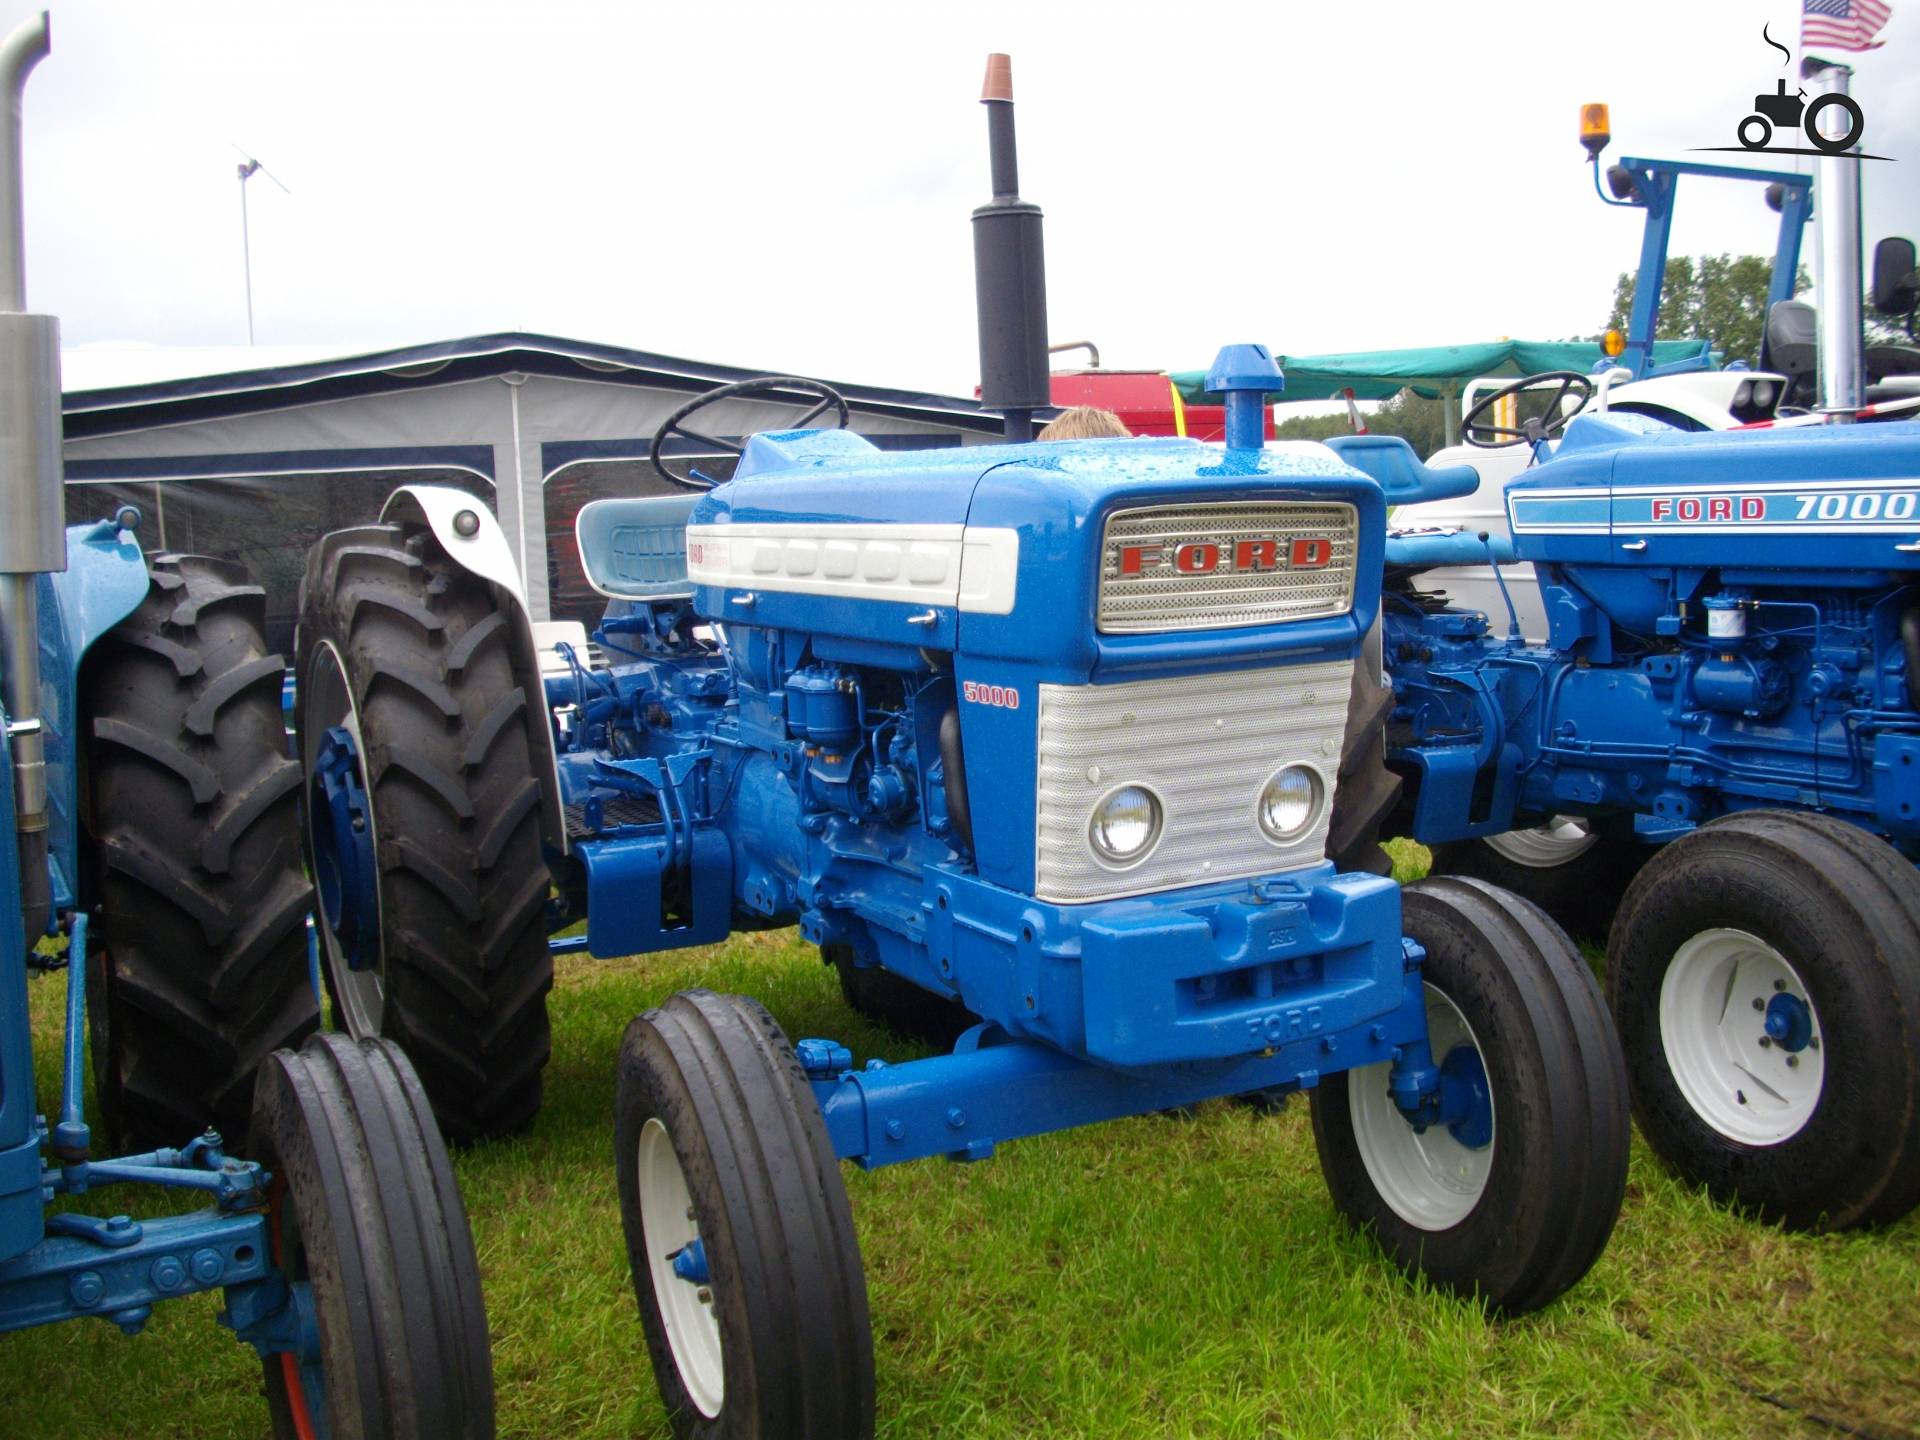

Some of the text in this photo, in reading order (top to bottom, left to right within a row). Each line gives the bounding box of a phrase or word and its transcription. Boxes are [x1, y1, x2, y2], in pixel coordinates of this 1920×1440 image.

[1651, 493, 1916, 522] FORD 7000
[1117, 535, 1333, 577] FORD
[963, 680, 1019, 709] 5000
